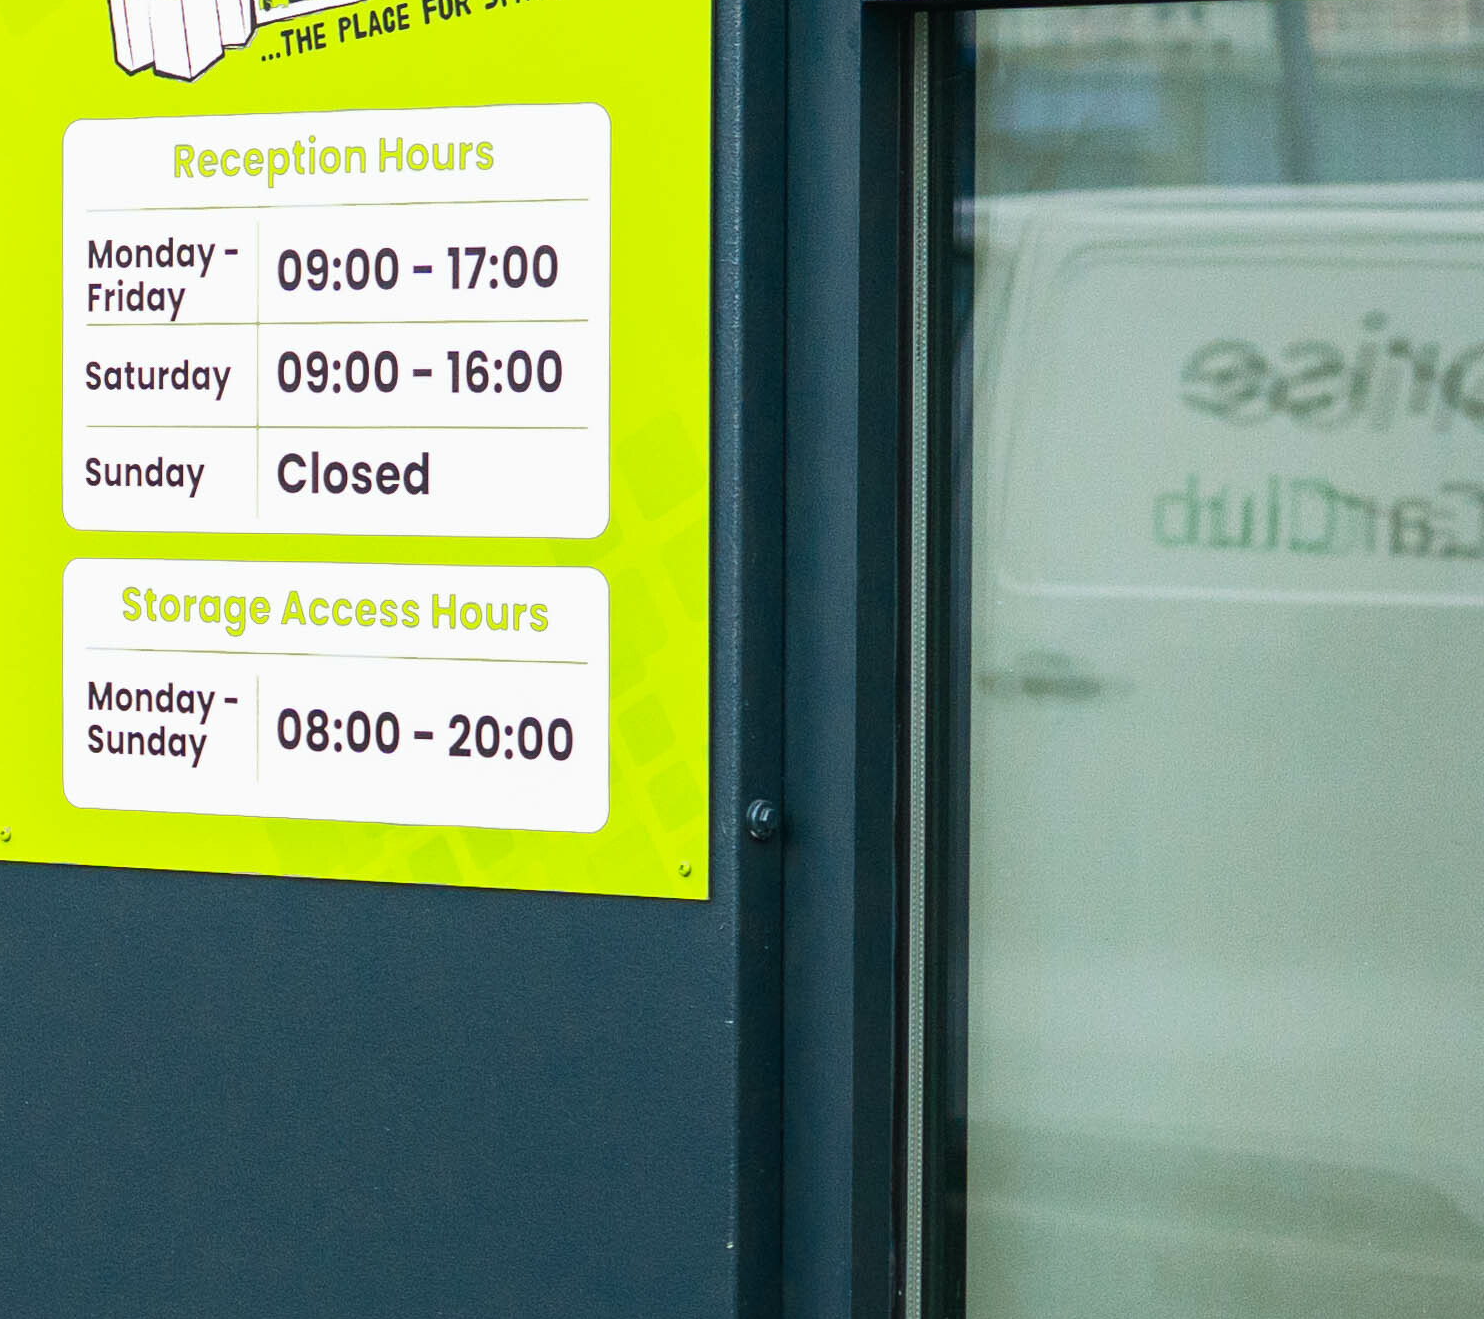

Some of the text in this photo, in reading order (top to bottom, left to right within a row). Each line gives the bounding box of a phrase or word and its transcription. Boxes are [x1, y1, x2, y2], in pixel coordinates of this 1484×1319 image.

[338, 3, 410, 43] PLACE
[173, 134, 496, 189] Reception Hours
[86, 237, 215, 279] Monday
[277, 248, 399, 292] 09:00
[447, 244, 559, 289] 17:00
[86, 280, 186, 322] Friday
[85, 360, 231, 401] Saturday
[277, 351, 399, 394] 09:00
[447, 349, 564, 394] 16:00
[85, 457, 205, 498] Sunday
[277, 452, 430, 495] Closed
[122, 586, 549, 637] Storage Access Hours
[86, 681, 215, 725] Monday
[86, 724, 208, 768] Sunday
[277, 710, 400, 754] 08:00
[449, 716, 573, 761] 20:00
